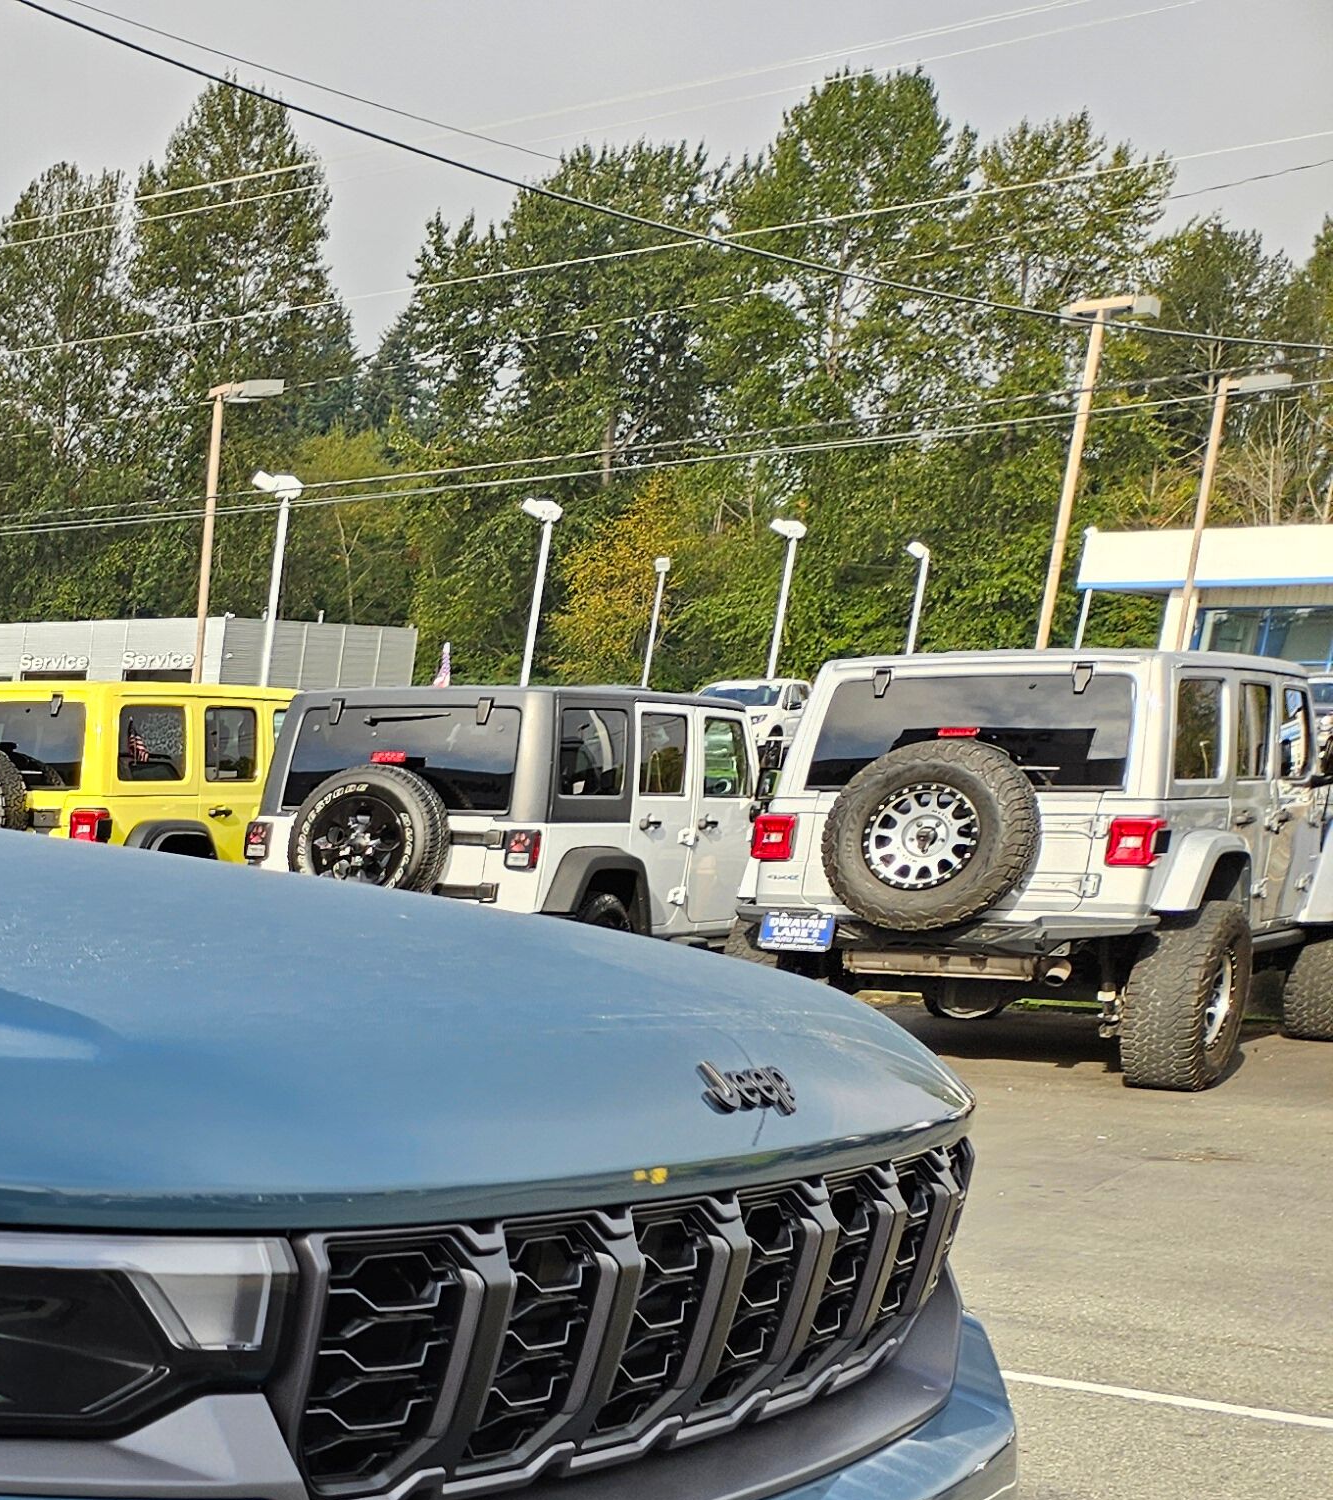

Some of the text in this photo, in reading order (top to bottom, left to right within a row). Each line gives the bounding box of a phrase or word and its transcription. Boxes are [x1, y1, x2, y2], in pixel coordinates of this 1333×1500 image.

[20, 652, 89, 670] Service
[122, 651, 195, 669] Service
[695, 1060, 797, 1117] Jeep
